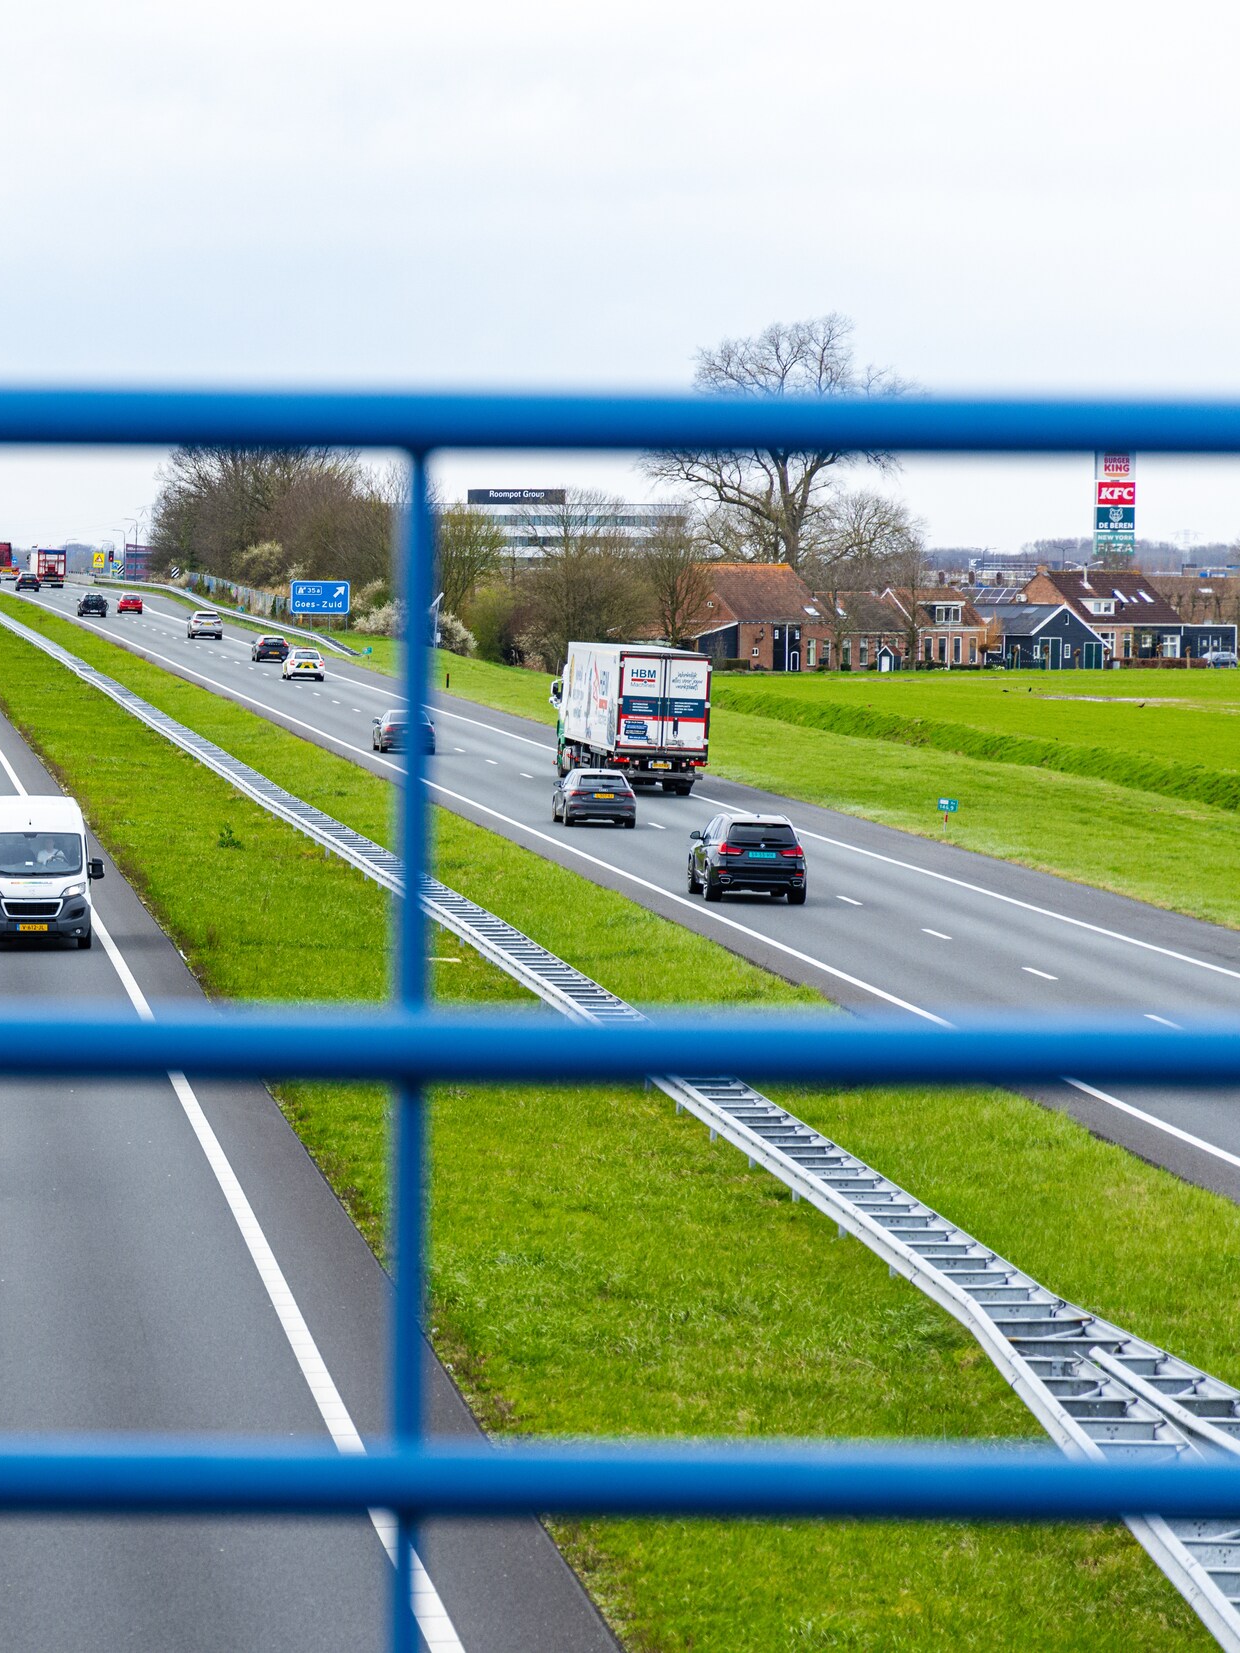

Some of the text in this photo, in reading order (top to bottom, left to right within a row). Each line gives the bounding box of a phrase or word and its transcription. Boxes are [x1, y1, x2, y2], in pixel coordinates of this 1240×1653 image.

[1104, 464, 1130, 472] KING
[489, 490, 545, 499] Roompot Group
[1099, 487, 1134, 499] KFC
[295, 600, 342, 608] Goes-Zuid
[631, 669, 656, 678] HBM
